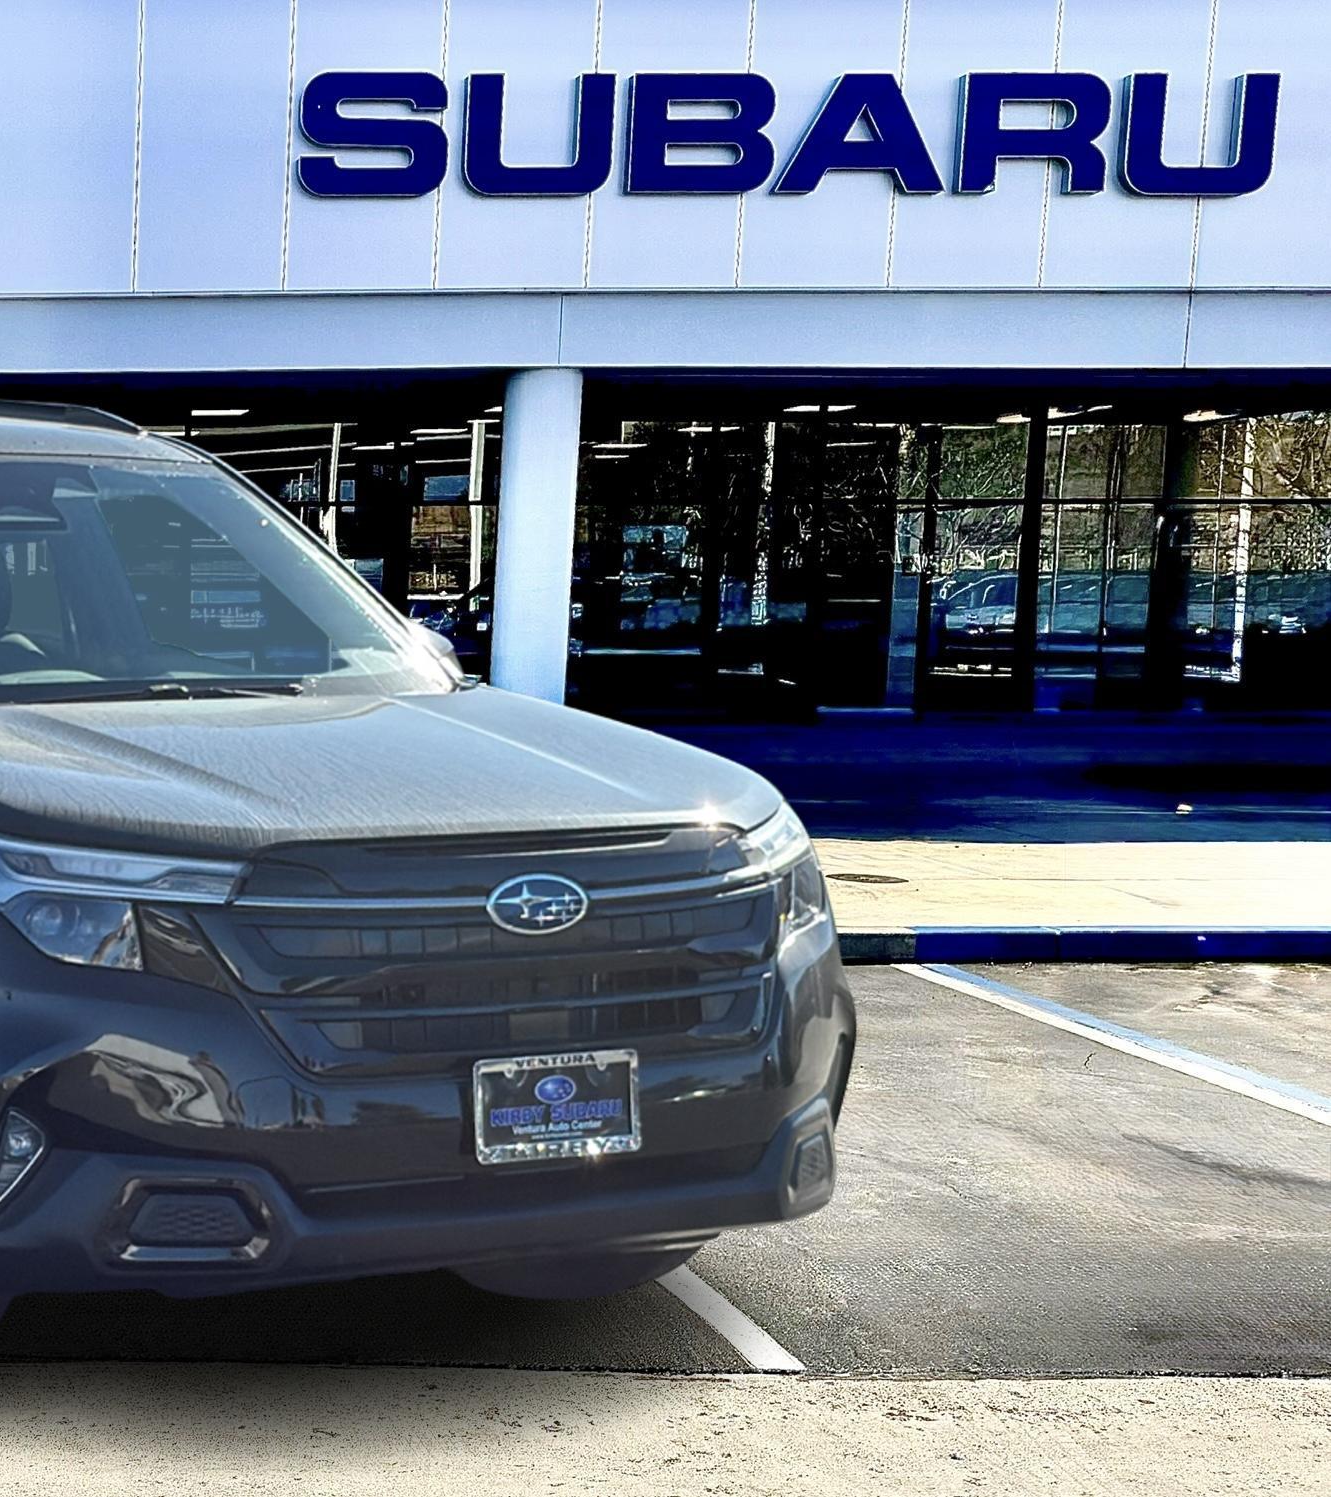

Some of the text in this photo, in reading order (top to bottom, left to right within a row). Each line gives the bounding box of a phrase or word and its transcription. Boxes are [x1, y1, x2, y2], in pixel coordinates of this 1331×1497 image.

[297, 70, 1281, 198] SUBARU
[515, 1053, 596, 1069] VENTURA
[490, 1098, 623, 1128] KIRBY SUBARU
[512, 1123, 546, 1136] Ventura
[548, 1121, 570, 1133] Auto
[571, 1119, 603, 1131] Center
